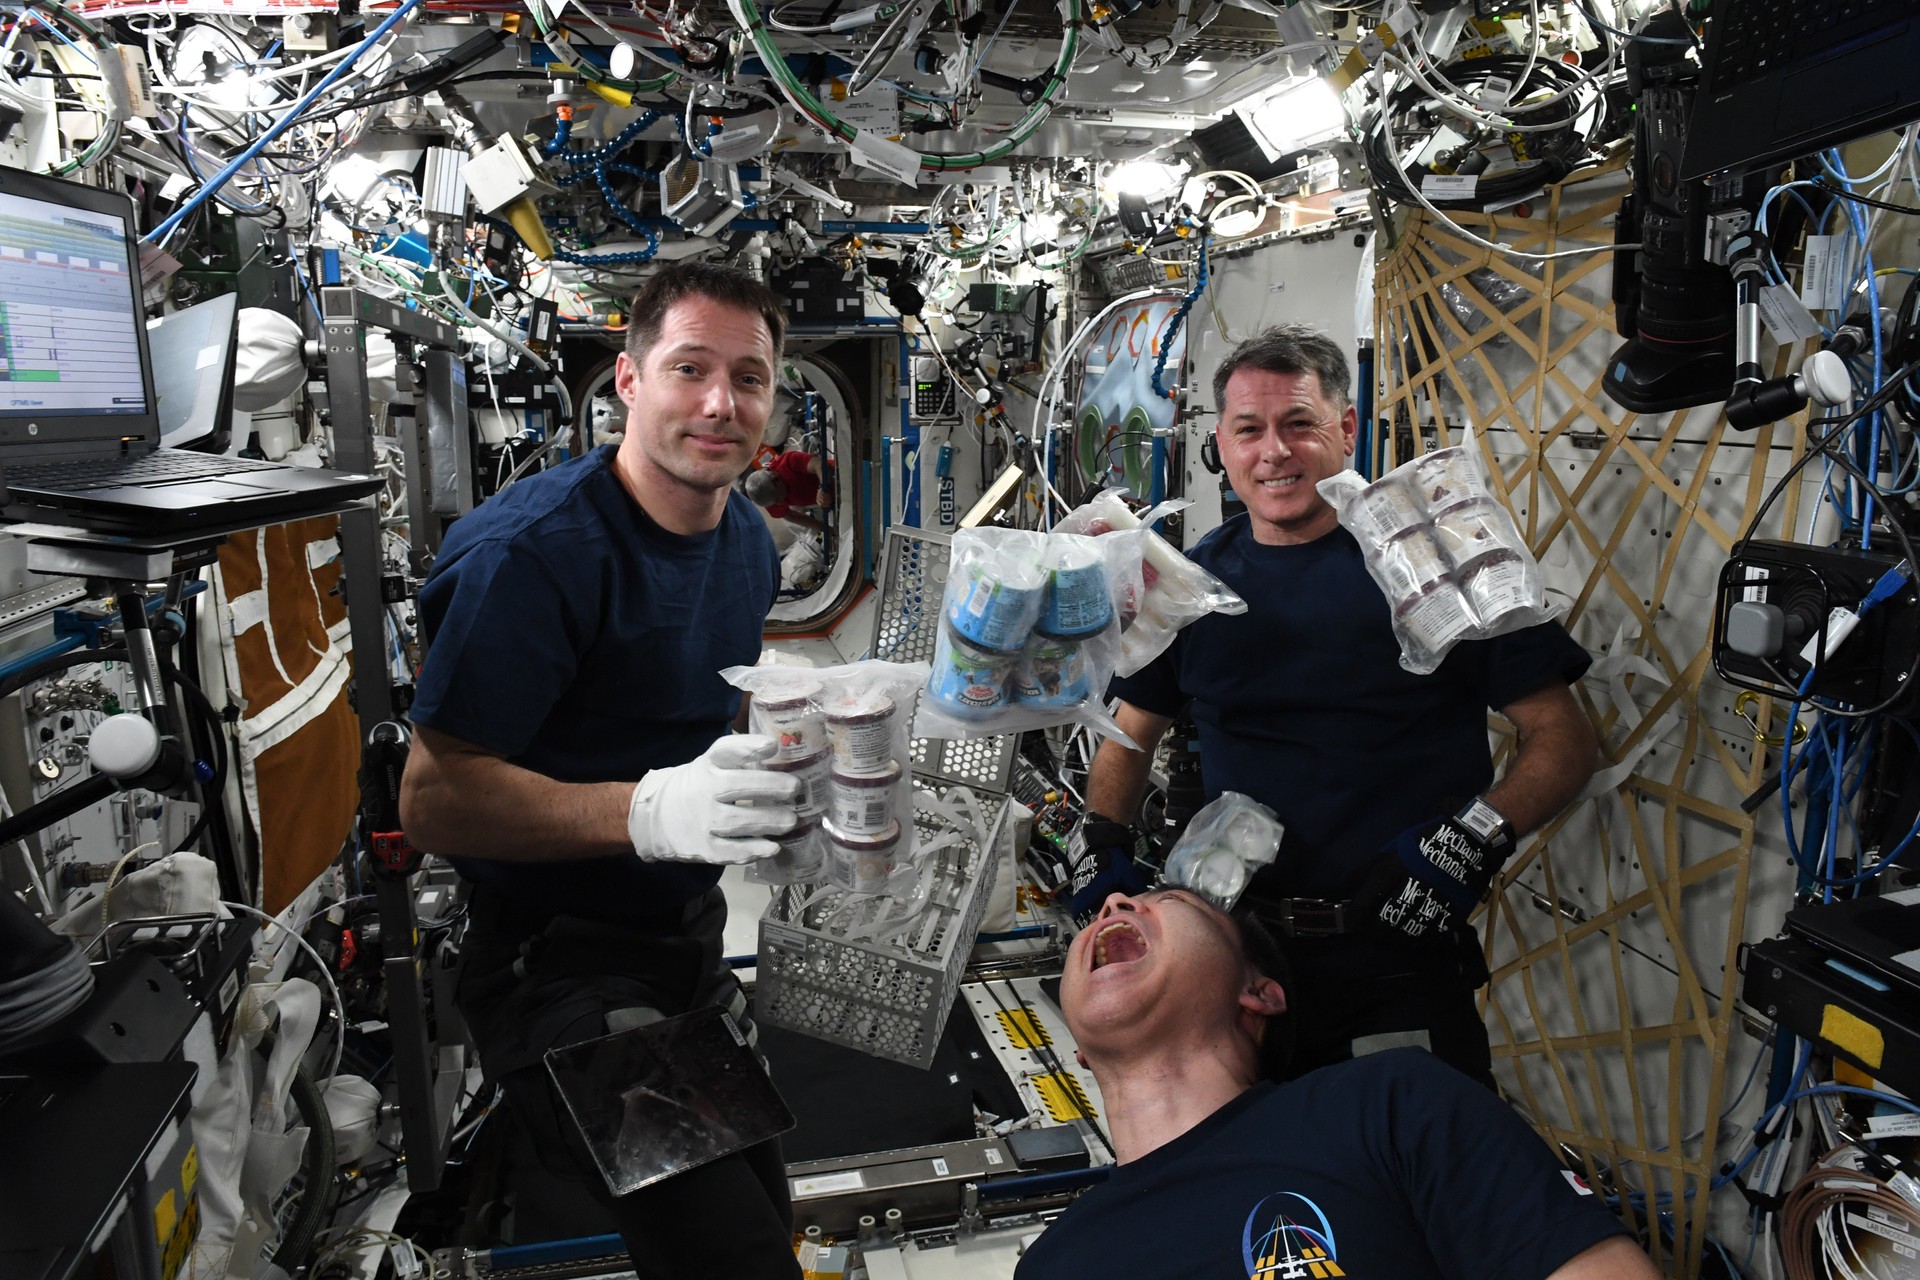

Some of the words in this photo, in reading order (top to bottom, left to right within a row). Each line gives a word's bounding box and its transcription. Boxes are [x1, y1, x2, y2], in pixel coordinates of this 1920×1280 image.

[940, 479, 954, 524] STBD
[1866, 1221, 1879, 1232] LAB
[1879, 1226, 1913, 1245] ENCODER
